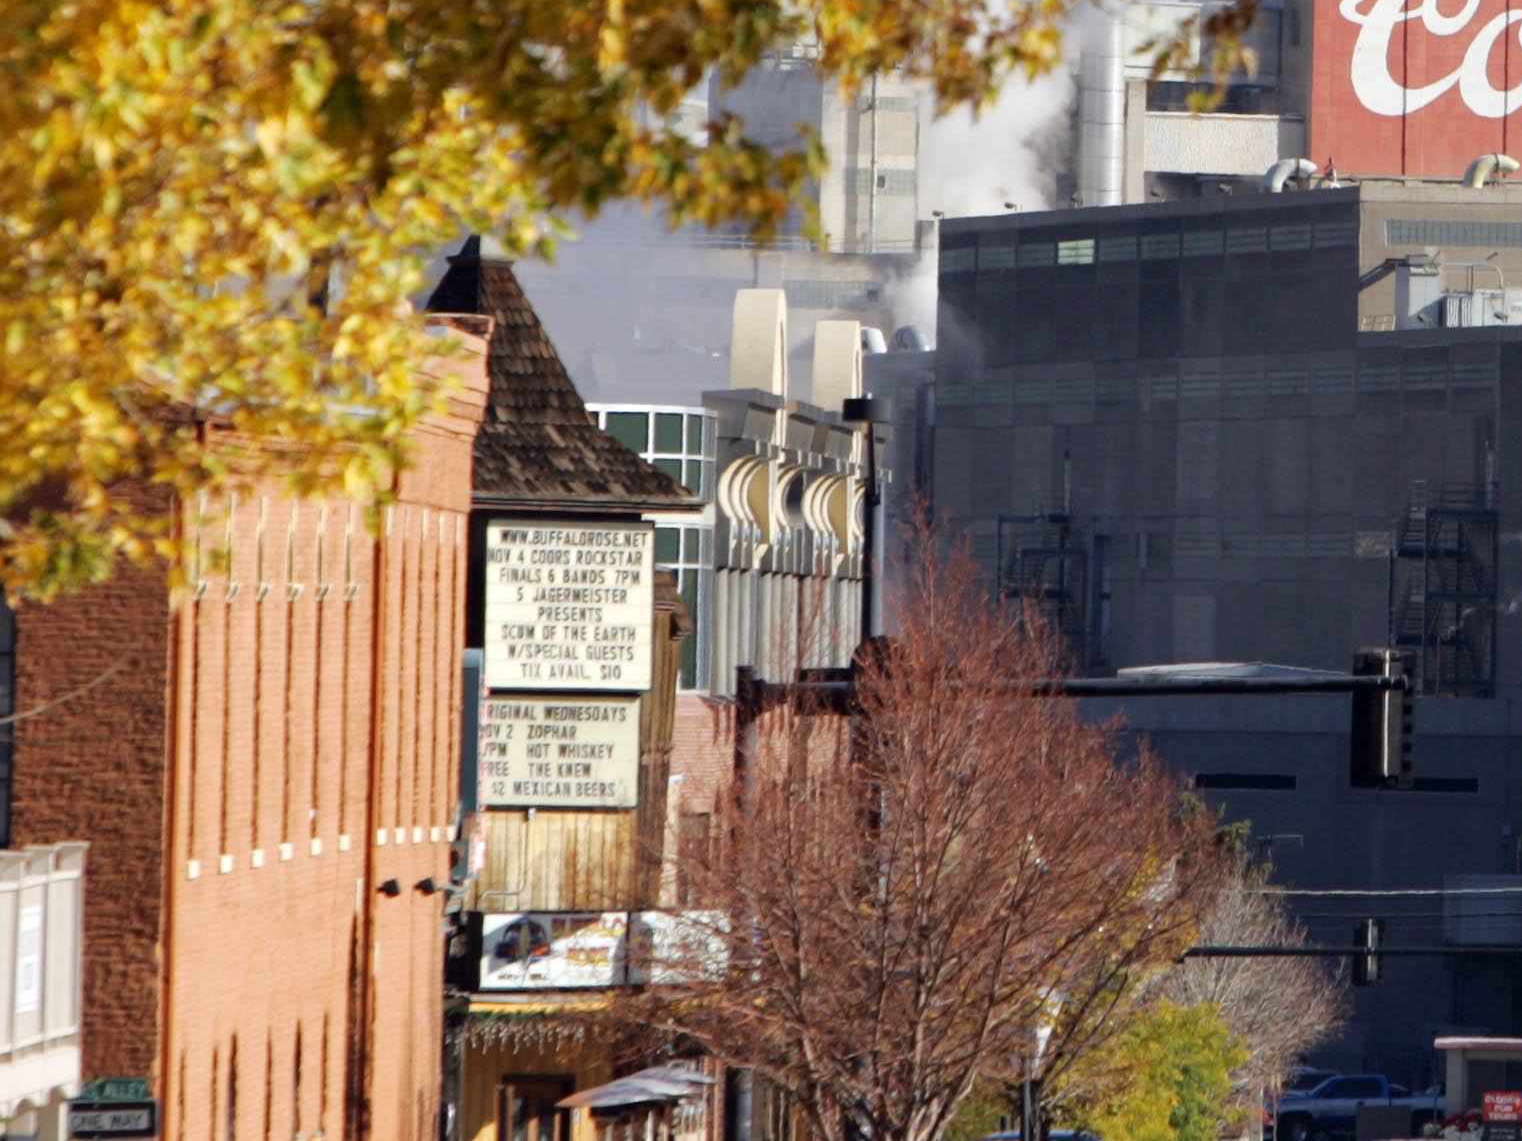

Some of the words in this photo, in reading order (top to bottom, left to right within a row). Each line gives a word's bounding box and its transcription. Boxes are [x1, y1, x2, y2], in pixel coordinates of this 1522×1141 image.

[501, 529, 648, 547] WWW.BUFFALOROSE.NET
[487, 548, 510, 563] NOV
[517, 550, 524, 563] 4
[531, 550, 570, 565] COORS
[576, 550, 643, 566] ROCKSTAR
[500, 568, 541, 583] FINALS
[562, 569, 605, 584] BANDS
[616, 570, 640, 584] 7PM
[533, 588, 627, 603] JAGERMEISTER
[538, 607, 603, 622] PRESENTS
[502, 624, 534, 640] SCUM
[542, 625, 556, 640] OF
[564, 626, 587, 641] THE
[594, 626, 636, 641] EARTH
[508, 644, 579, 660] W/SPECIAL
[586, 645, 634, 661] GUESTS
[520, 663, 541, 678] TIX
[544, 706, 626, 722] WEDNESDAYS
[506, 725, 513, 739] 2
[527, 726, 577, 740] ZOPHAR
[527, 744, 551, 759] HOT
[558, 744, 615, 759] WHISKEY
[480, 761, 509, 776] FREE
[528, 762, 551, 777] THE
[557, 763, 592, 778] KNEW
[513, 782, 571, 796] MEXICAN
[576, 782, 616, 797] BEERS
[72, 1114, 103, 1130] ONE
[111, 1112, 145, 1129] WAY
